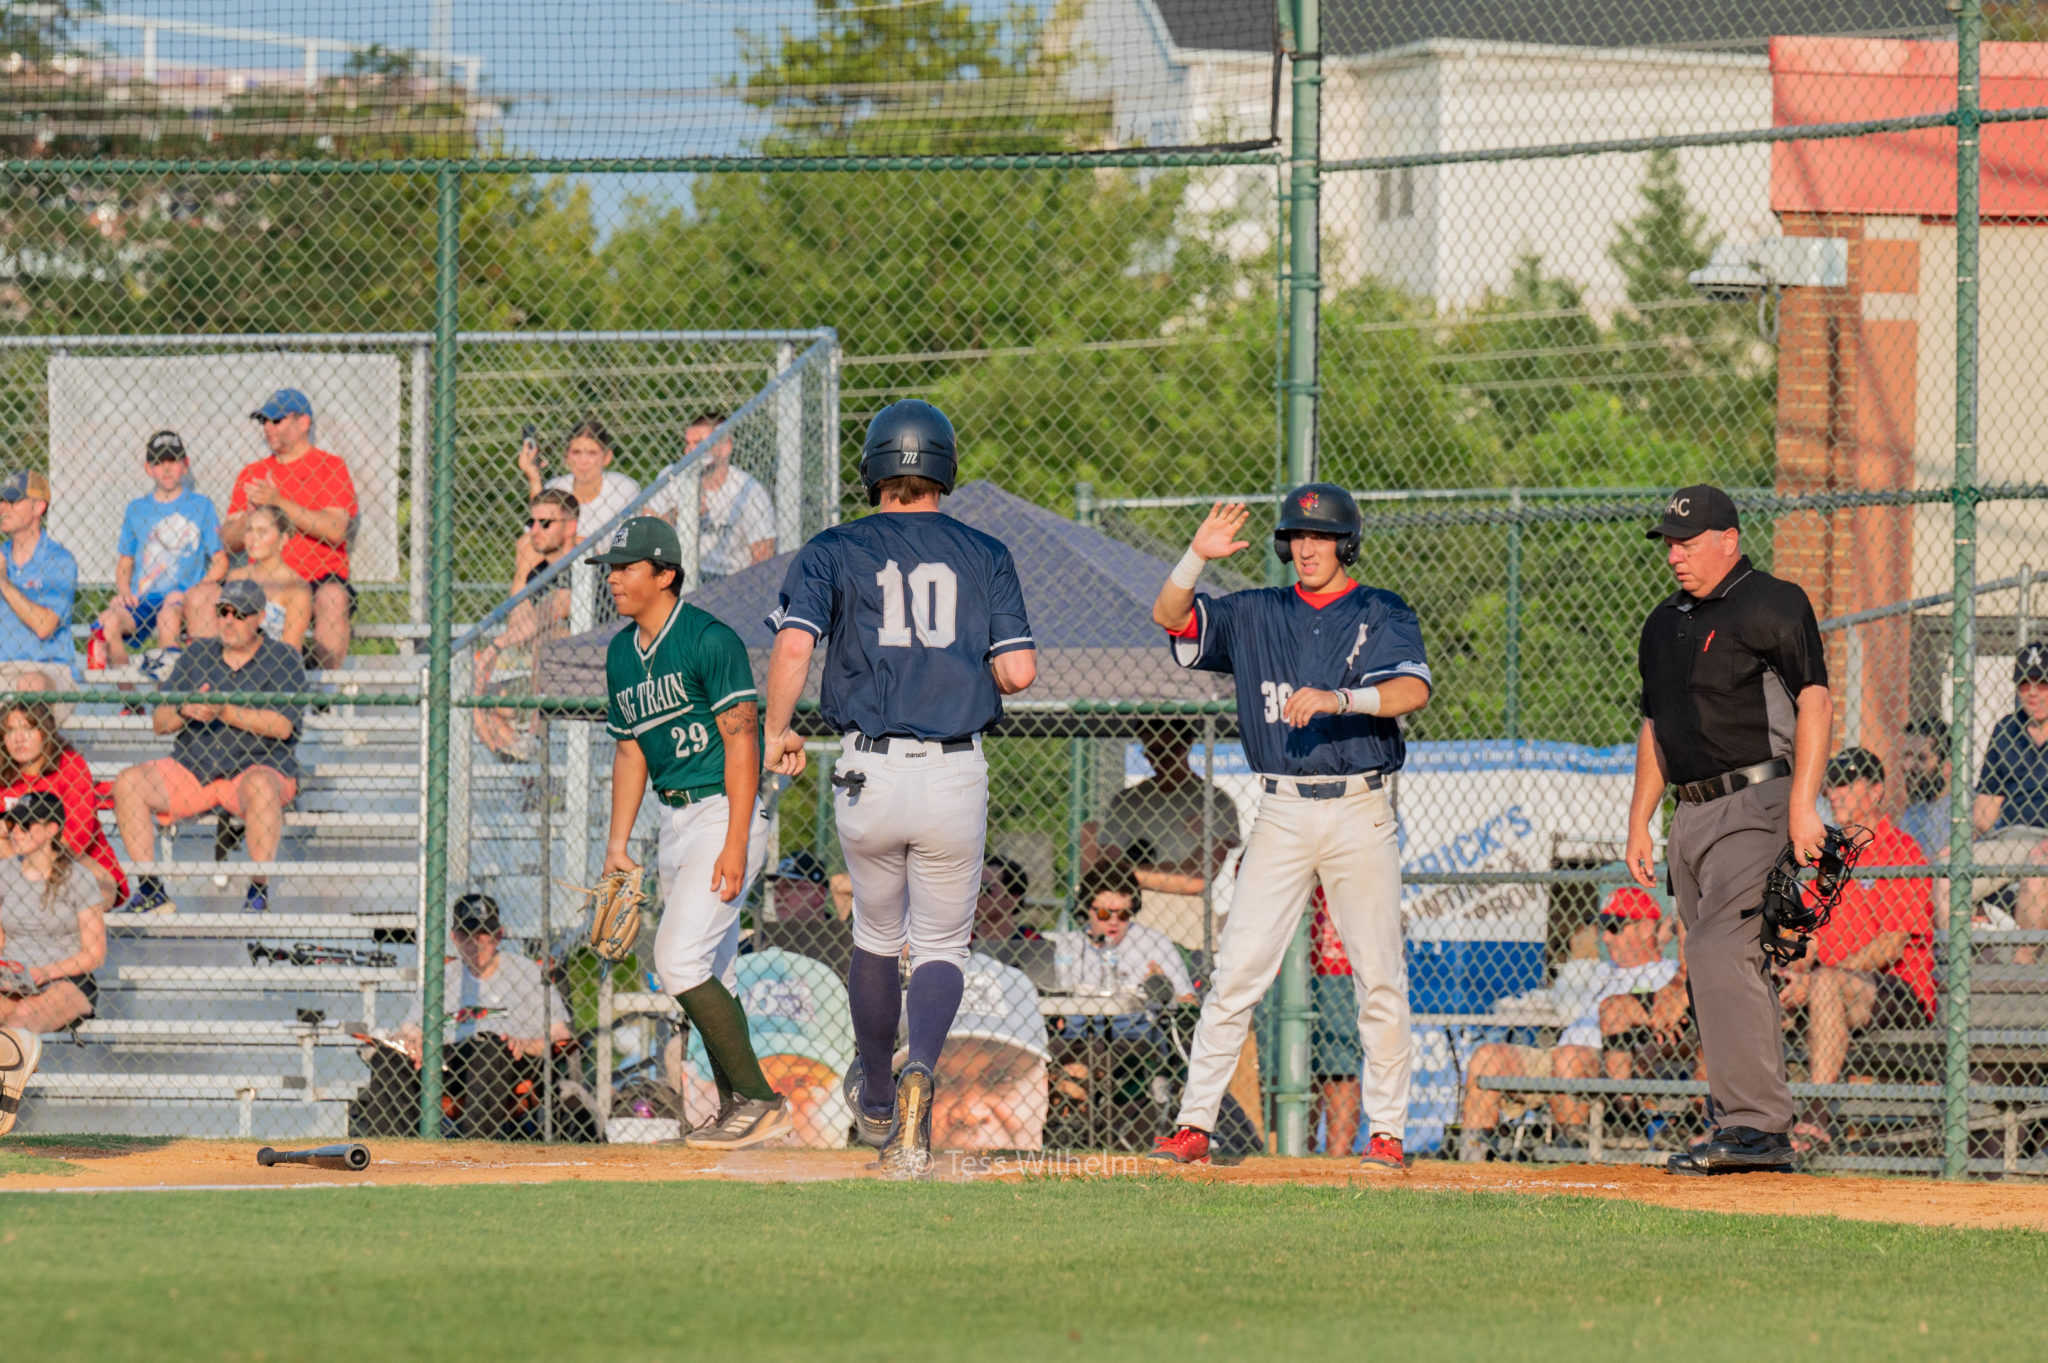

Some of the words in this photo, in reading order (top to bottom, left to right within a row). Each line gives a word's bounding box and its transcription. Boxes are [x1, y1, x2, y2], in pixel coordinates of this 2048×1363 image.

[876, 559, 957, 649] 10
[637, 672, 689, 718] TRAIN
[671, 722, 708, 758] 29
